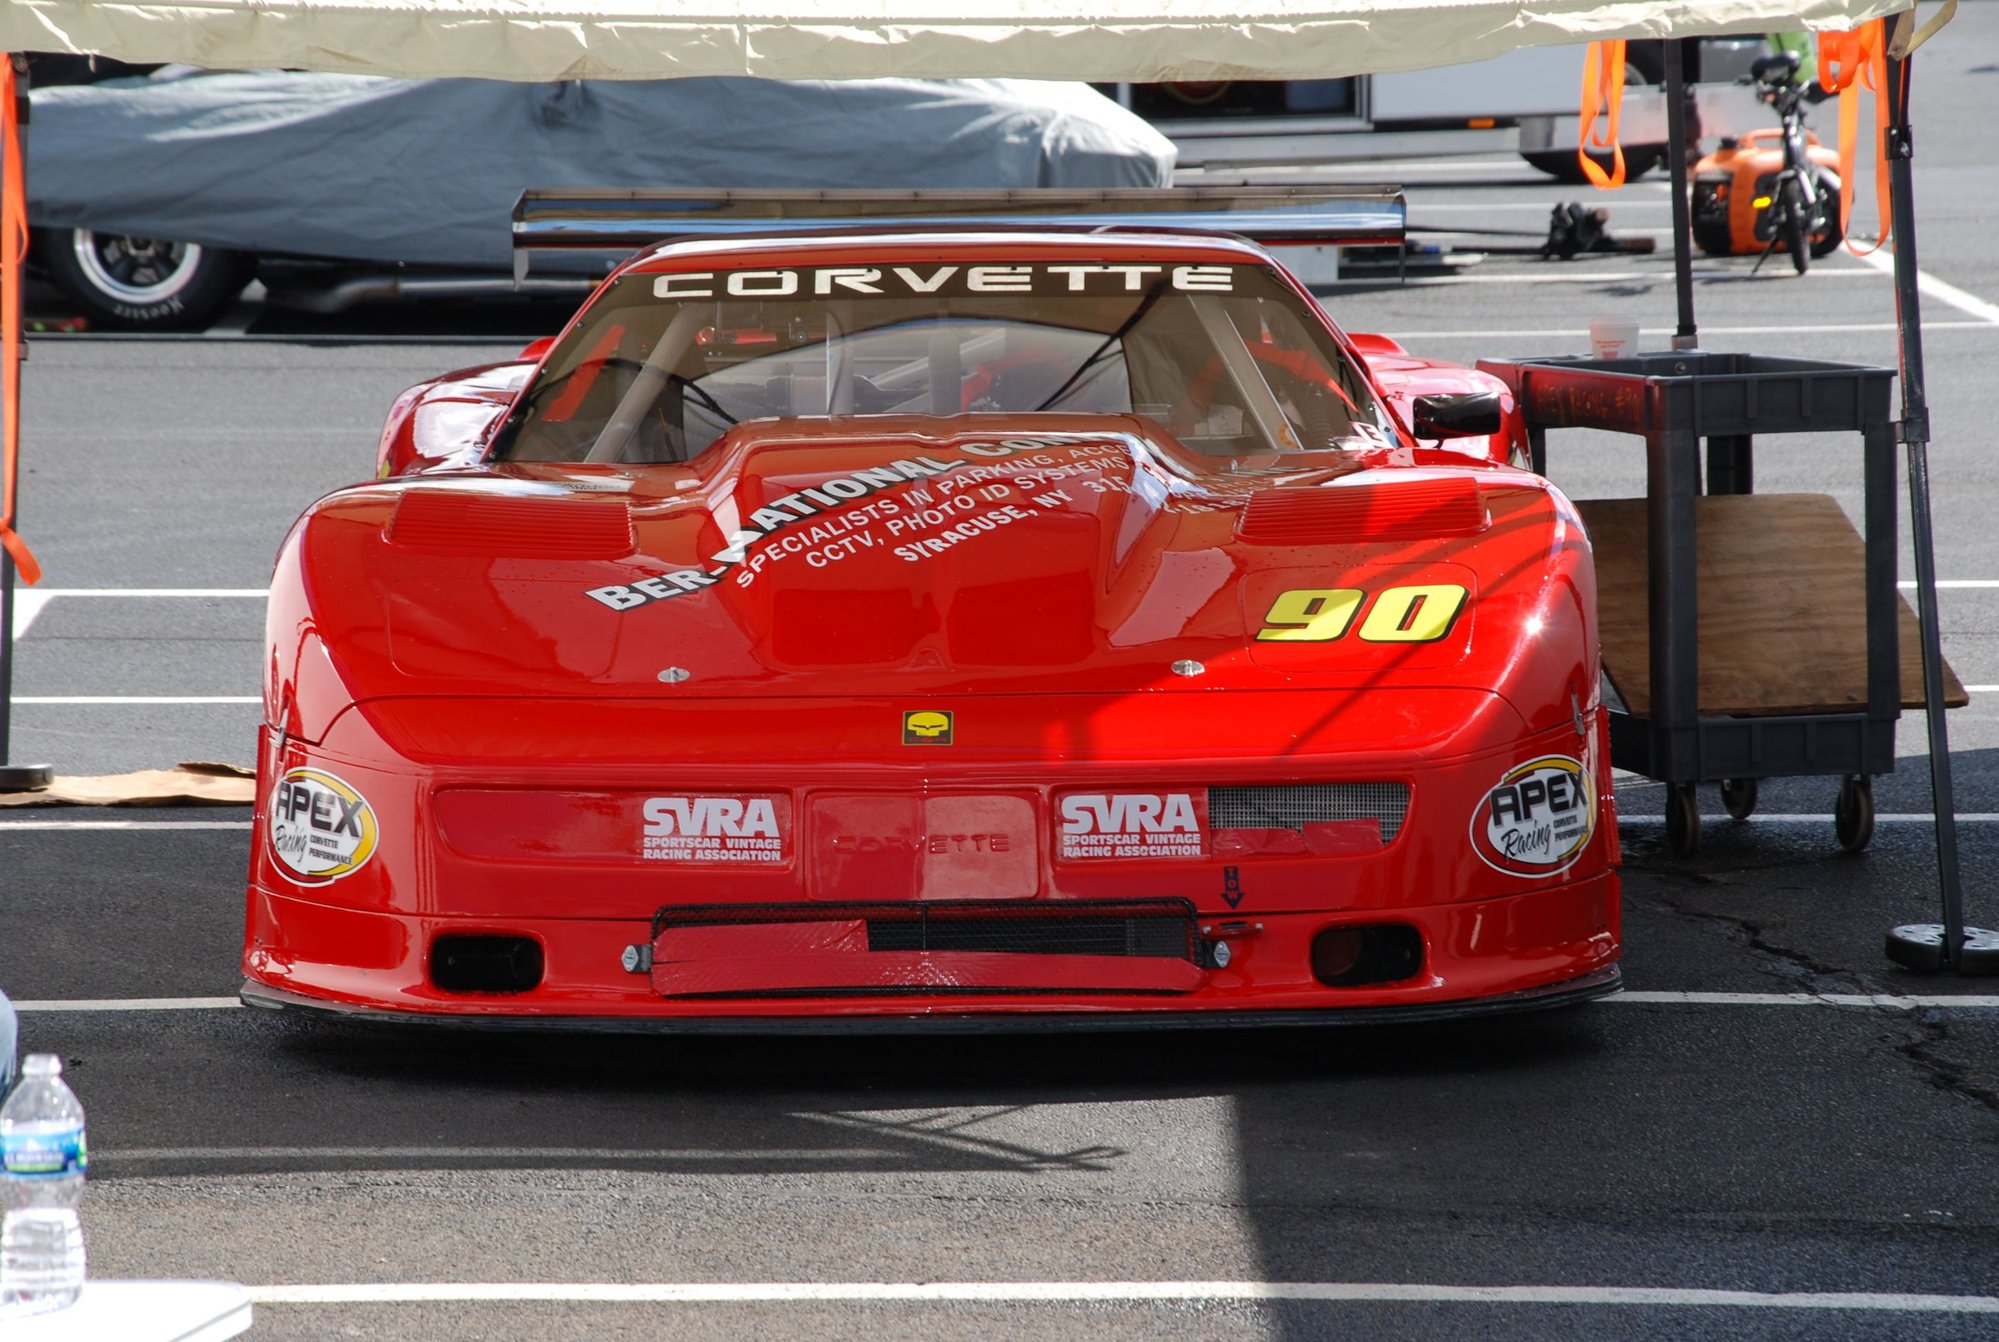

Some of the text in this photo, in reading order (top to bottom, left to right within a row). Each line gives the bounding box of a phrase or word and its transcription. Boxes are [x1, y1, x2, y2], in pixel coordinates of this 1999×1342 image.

[653, 265, 1233, 298] CORVETTE
[736, 499, 900, 589] SPECIALISTS
[902, 488, 935, 507] IN
[937, 454, 1064, 495] PARKING,
[806, 456, 1130, 568] CCTV, PHOTO ID SYSTEMS
[894, 504, 1039, 562] SYRACUSE,
[1032, 488, 1074, 508] NY
[1254, 584, 1470, 644] 90
[276, 780, 365, 838] APEX
[643, 797, 780, 838] SVRA
[1060, 793, 1199, 834] SVRA
[1490, 769, 1587, 827] APEX
[309, 847, 353, 866] PERFORMANCE
[310, 834, 338, 849] CORVETTE
[643, 837, 782, 849] SPORTSCAR VINTAGE
[643, 849, 781, 861] RACING ASSOCIATION
[1062, 833, 1201, 847] SPORTSCAR VINTAGE
[1062, 845, 1201, 858] RACING ASSOCIATION
[1501, 819, 1551, 860] Racing
[1226, 867, 1238, 900] TOW
